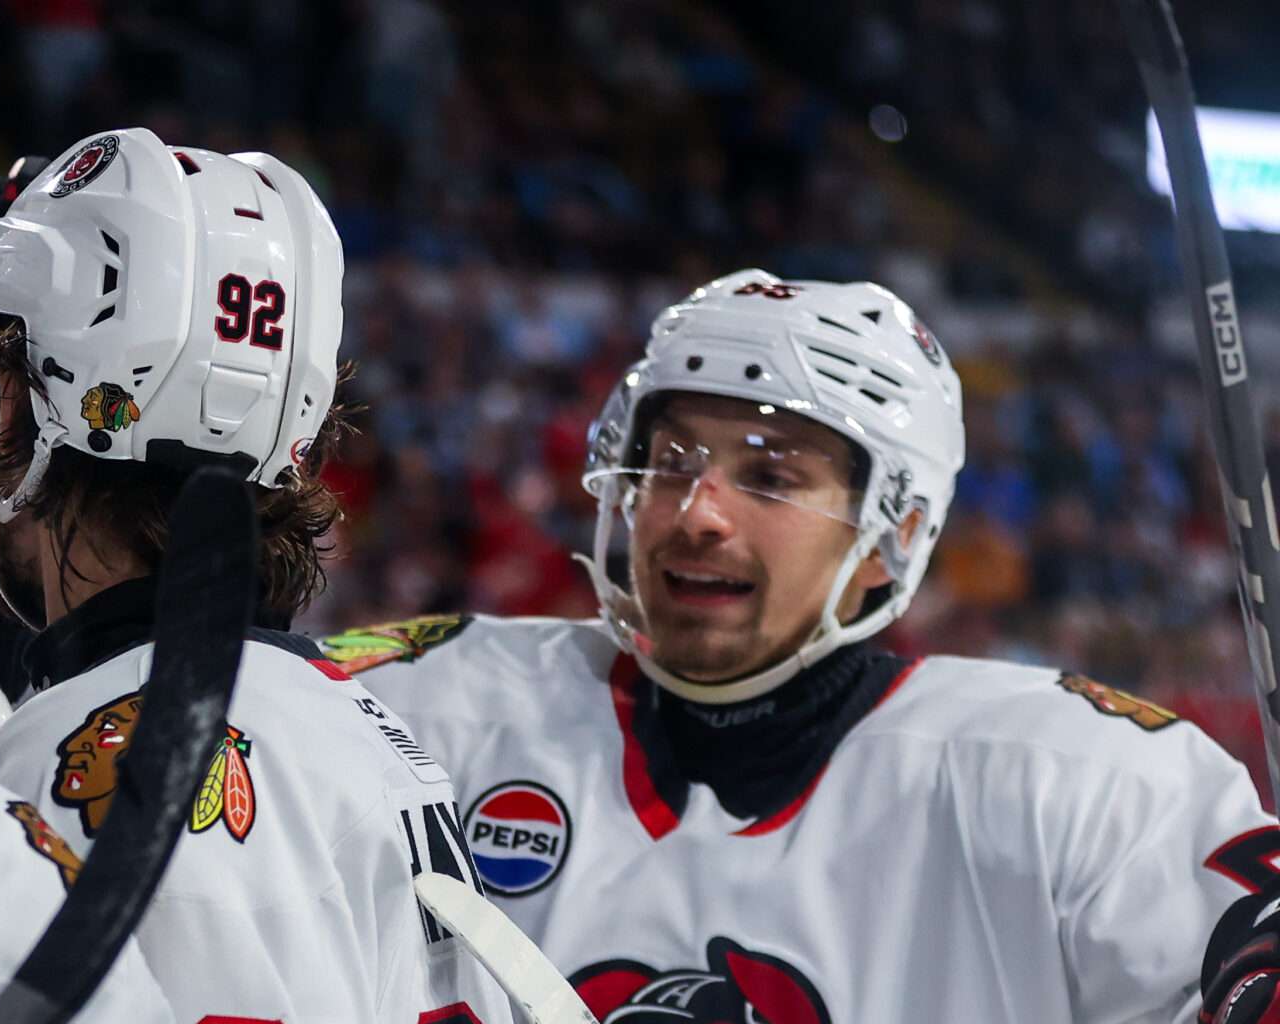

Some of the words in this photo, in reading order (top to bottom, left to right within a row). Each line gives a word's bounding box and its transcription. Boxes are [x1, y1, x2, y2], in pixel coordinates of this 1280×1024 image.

[215, 273, 287, 351] 92
[1214, 293, 1243, 378] CCM
[471, 820, 559, 857] PEPSI
